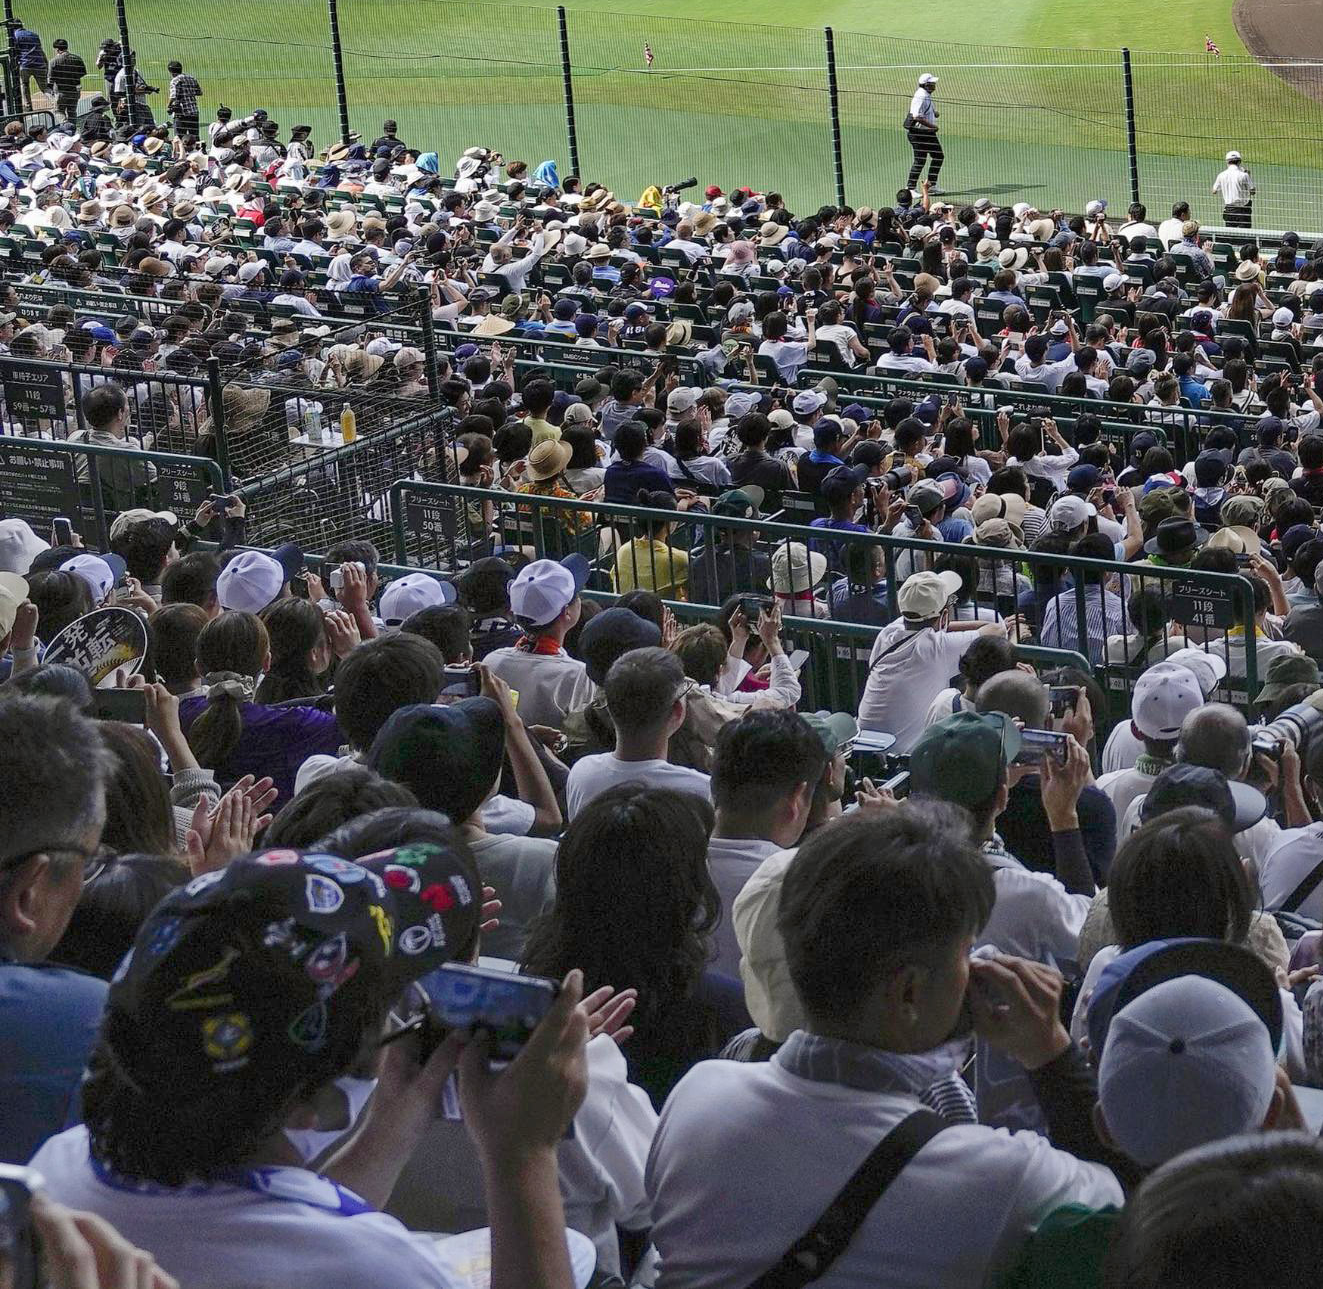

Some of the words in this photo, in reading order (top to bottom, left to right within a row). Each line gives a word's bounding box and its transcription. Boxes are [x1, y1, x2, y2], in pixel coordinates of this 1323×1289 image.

[423, 509, 441, 520] 11段
[422, 520, 443, 533] 50番
[1179, 585, 1227, 599] ブリーズシート
[1193, 600, 1214, 613] 11段
[1193, 613, 1216, 626] 41番
